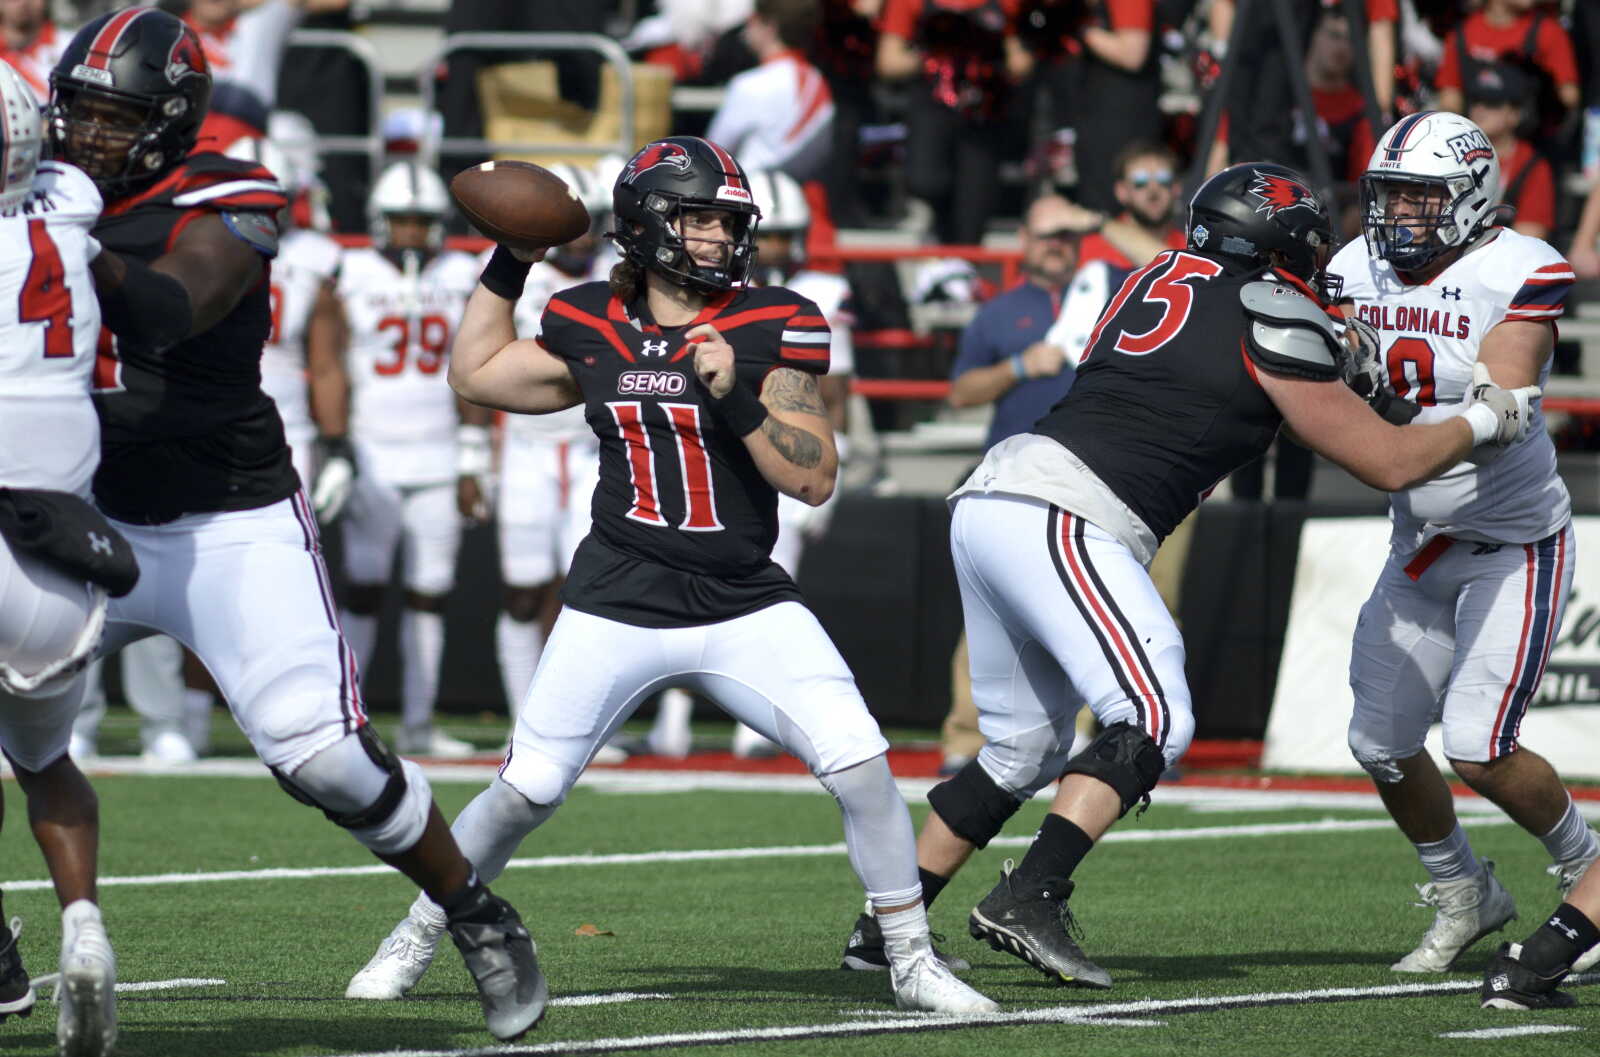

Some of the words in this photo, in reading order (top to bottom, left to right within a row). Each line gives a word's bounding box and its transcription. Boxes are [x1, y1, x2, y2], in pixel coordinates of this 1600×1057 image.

[1379, 161, 1401, 169] UNITE
[18, 218, 75, 359] 4
[373, 313, 449, 377] 39
[1359, 304, 1470, 340] COLONIALS
[618, 371, 686, 396] SEMO
[604, 400, 726, 532] 11
